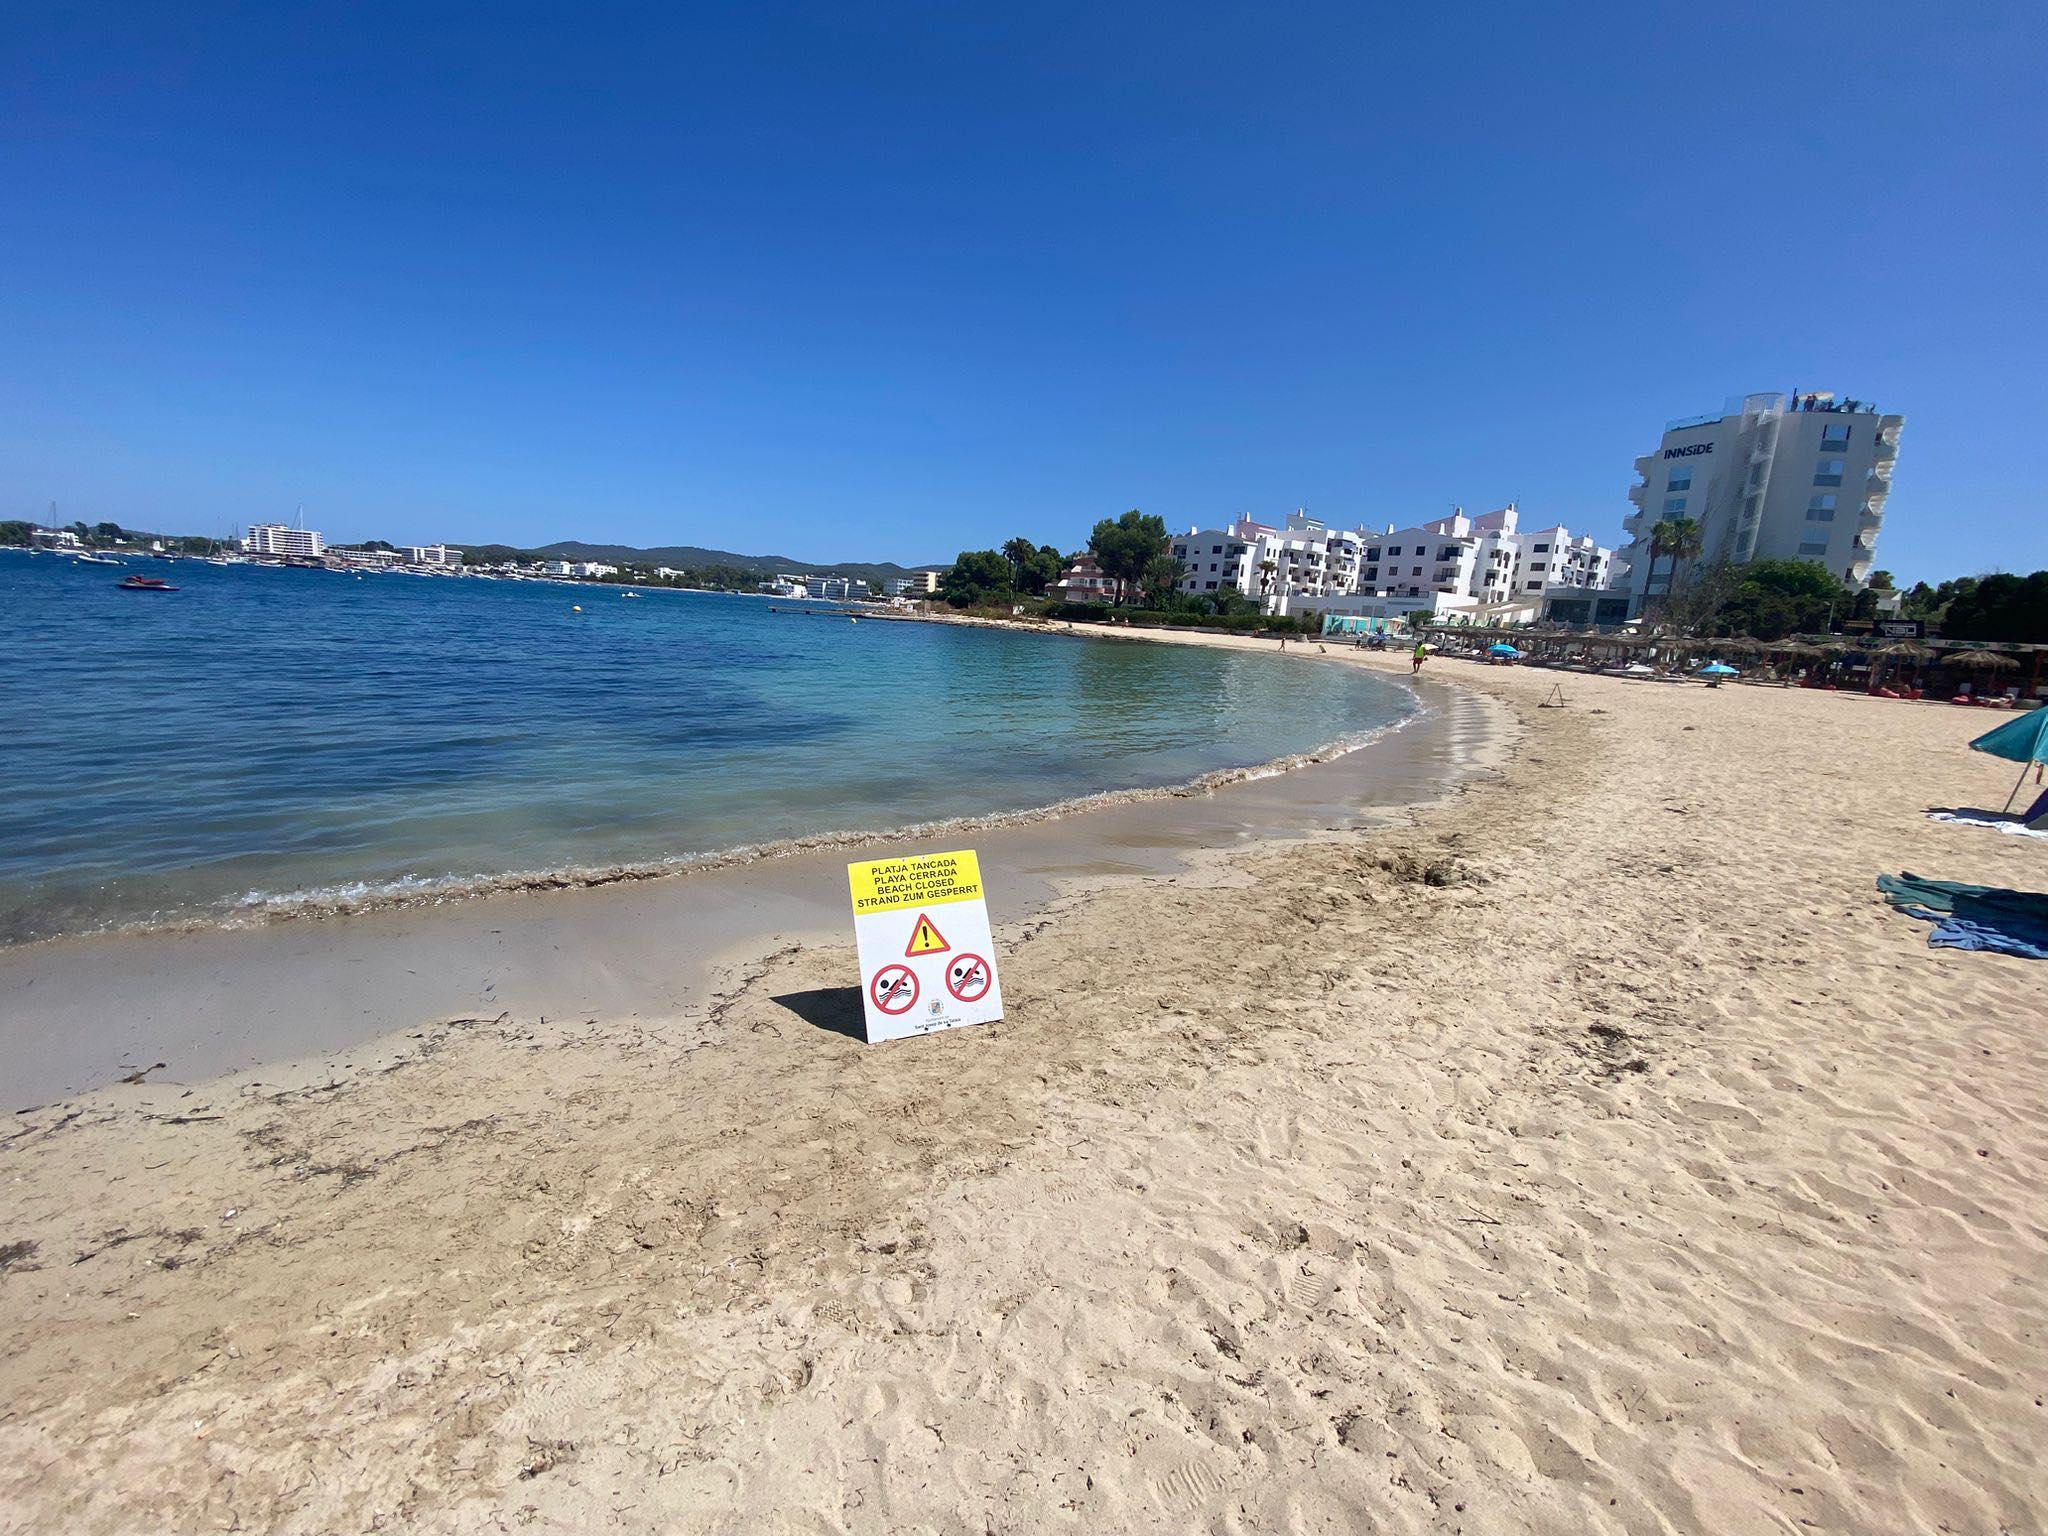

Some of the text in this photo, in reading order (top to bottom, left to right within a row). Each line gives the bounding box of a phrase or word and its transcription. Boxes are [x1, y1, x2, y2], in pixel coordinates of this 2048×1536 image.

[872, 859, 957, 875] PLATJA TANCADA
[874, 868, 957, 885] PLAYA CERRADA
[877, 878, 955, 895] BEACH CLOSED
[857, 884, 978, 908] STRAND ZUM GESPERRT
